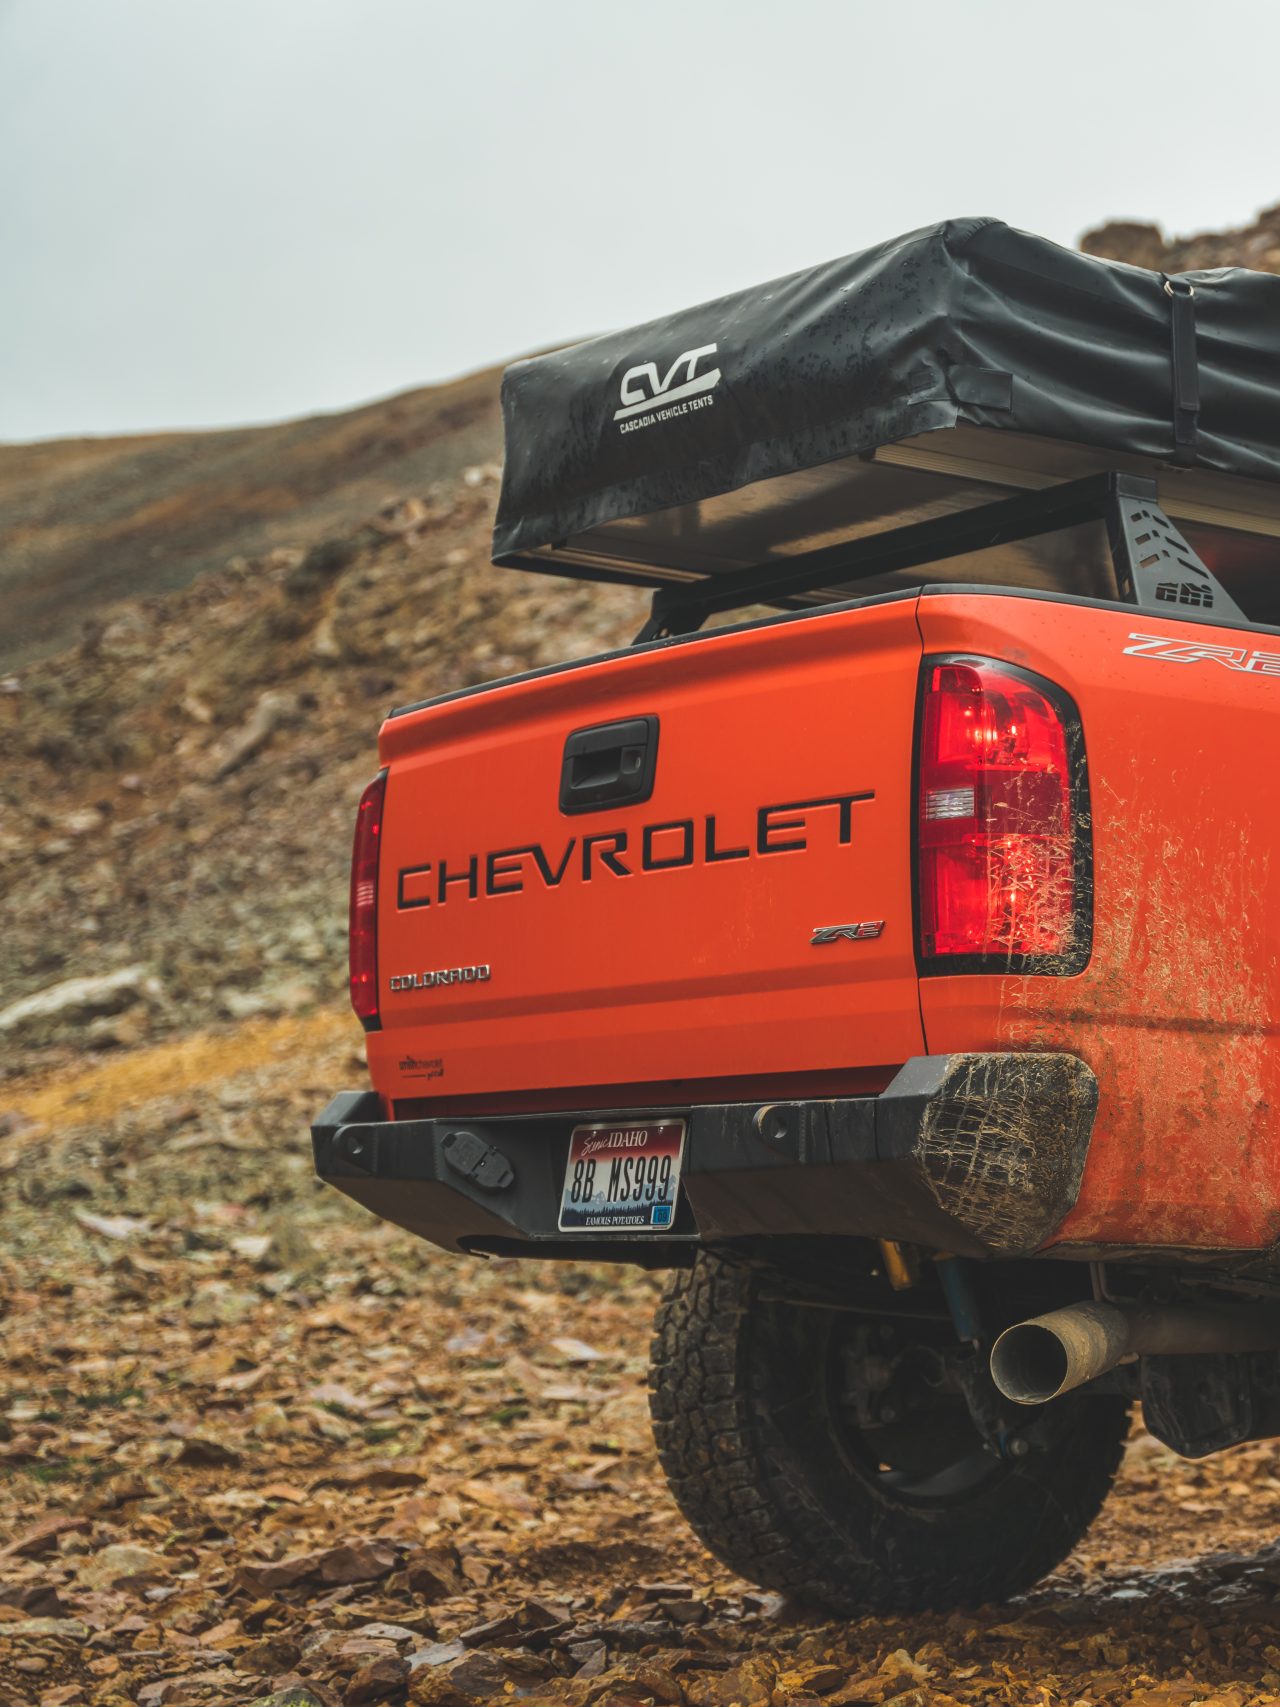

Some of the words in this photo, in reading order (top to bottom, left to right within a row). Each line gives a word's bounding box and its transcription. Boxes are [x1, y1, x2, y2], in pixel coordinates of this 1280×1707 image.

[620, 342, 717, 406] CVT
[619, 415, 656, 434] CASCADIA
[656, 403, 689, 422] VEHICLE
[688, 394, 714, 412] TENTS
[396, 789, 876, 911] CHEVROLET
[809, 920, 885, 944] ZR2
[389, 964, 490, 992] COLORADO
[608, 1130, 648, 1148] IDAHO
[570, 1158, 597, 1204] 8B
[606, 1154, 672, 1203] MS999
[585, 1217, 612, 1226] FAMOUS
[611, 1215, 645, 1225] POTATOES
